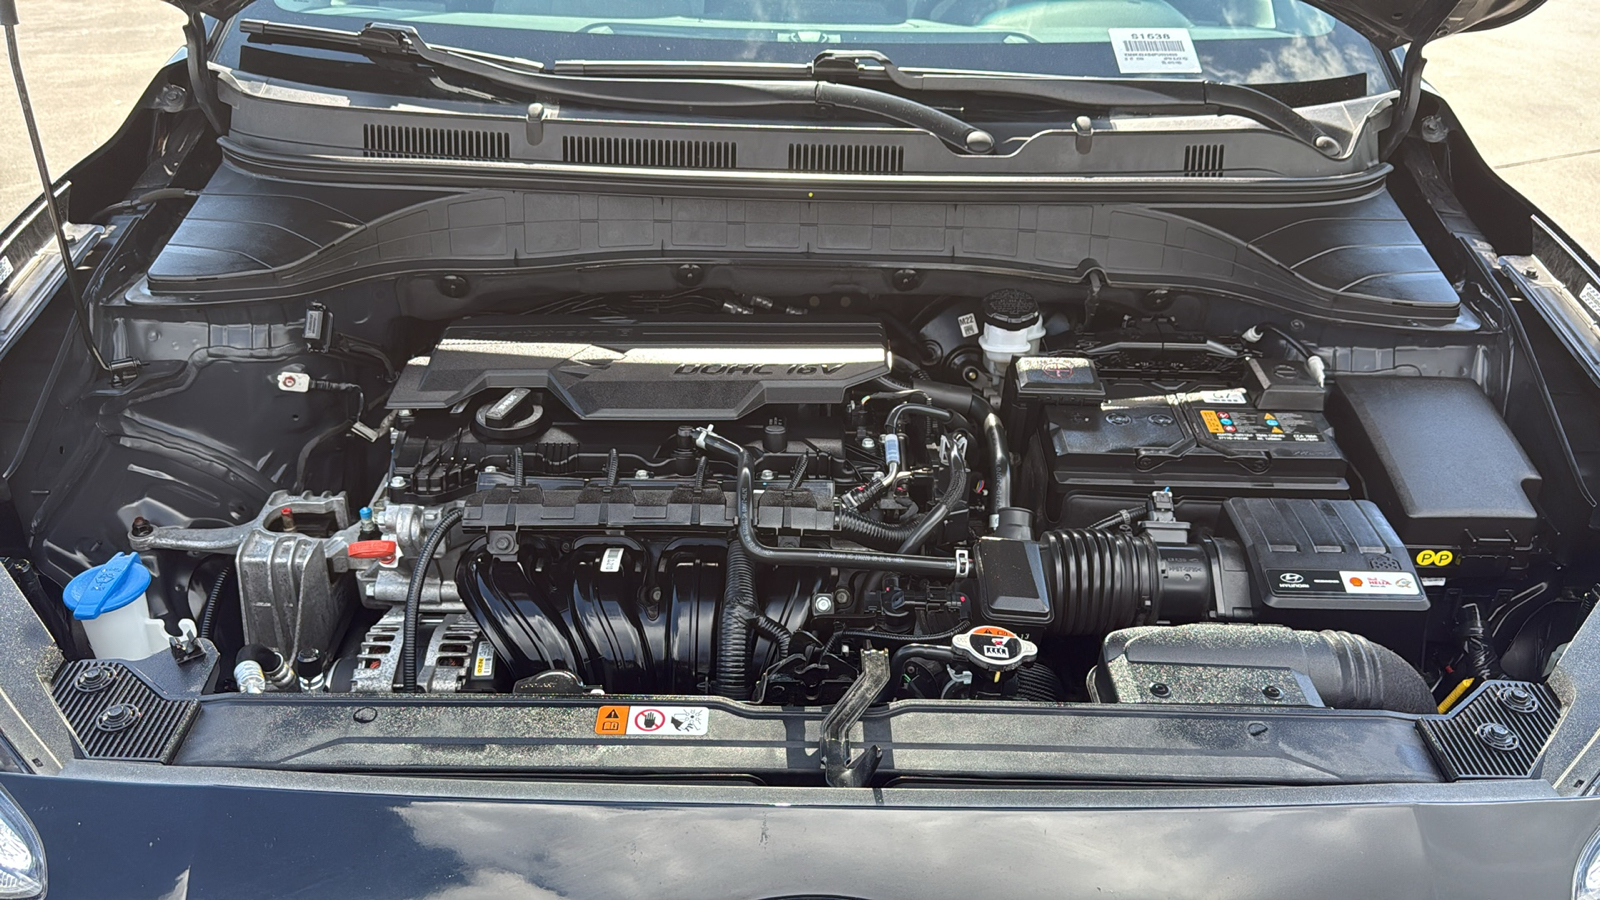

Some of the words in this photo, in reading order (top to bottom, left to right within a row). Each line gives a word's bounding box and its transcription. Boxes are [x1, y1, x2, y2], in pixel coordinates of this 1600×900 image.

[673, 362, 778, 375] DOHC
[786, 362, 847, 376] 16V
[1421, 553, 1433, 563] P
[1438, 554, 1450, 564] P
